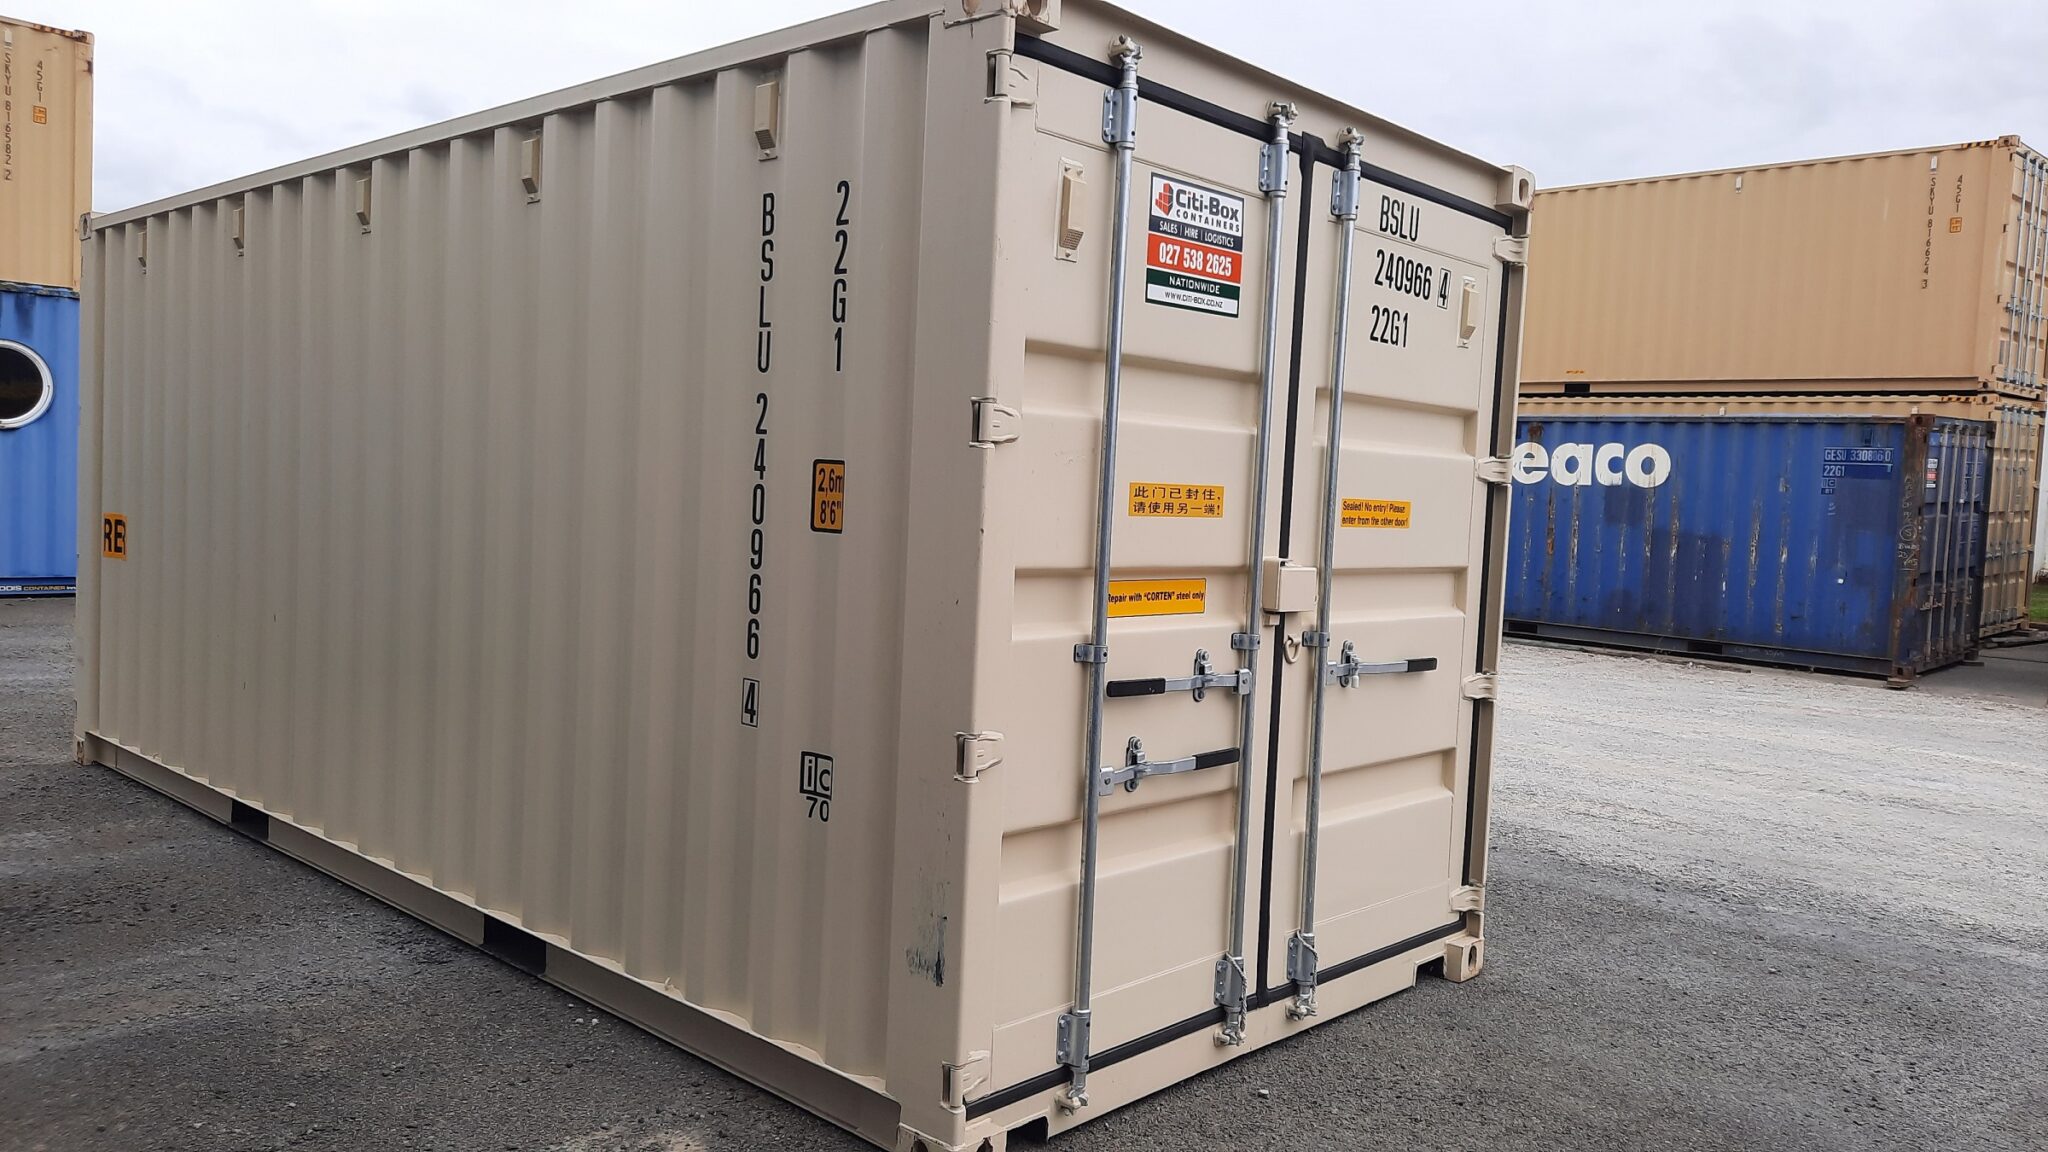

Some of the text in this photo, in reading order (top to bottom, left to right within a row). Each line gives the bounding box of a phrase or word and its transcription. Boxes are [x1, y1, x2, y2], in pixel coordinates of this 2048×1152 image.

[1175, 189, 1240, 223] Citi-Box
[1379, 194, 1420, 242] BSLU
[1159, 220, 1234, 248] SALES HIRE LOGISTICS
[1176, 208, 1240, 233] CONTAINERS
[1159, 242, 1232, 277] 027 538 2625
[832, 180, 850, 372] 22G1
[1169, 275, 1221, 294] NATIONWIDE
[1374, 249, 1449, 307] 240966 4
[1369, 305, 1409, 348] 22G1
[743, 192, 775, 724] BSLU 240966 4
[1512, 442, 1671, 488] eaco
[1824, 449, 1847, 461] GESU
[1823, 465, 1845, 477] 22G1
[1342, 501, 1405, 514] Sealed! No entry! Please
[1342, 515, 1408, 527] enter from the other door!
[1128, 593, 1142, 602] with
[1176, 591, 1191, 600] steel
[1192, 590, 1205, 601] only
[806, 795, 830, 823] 70
